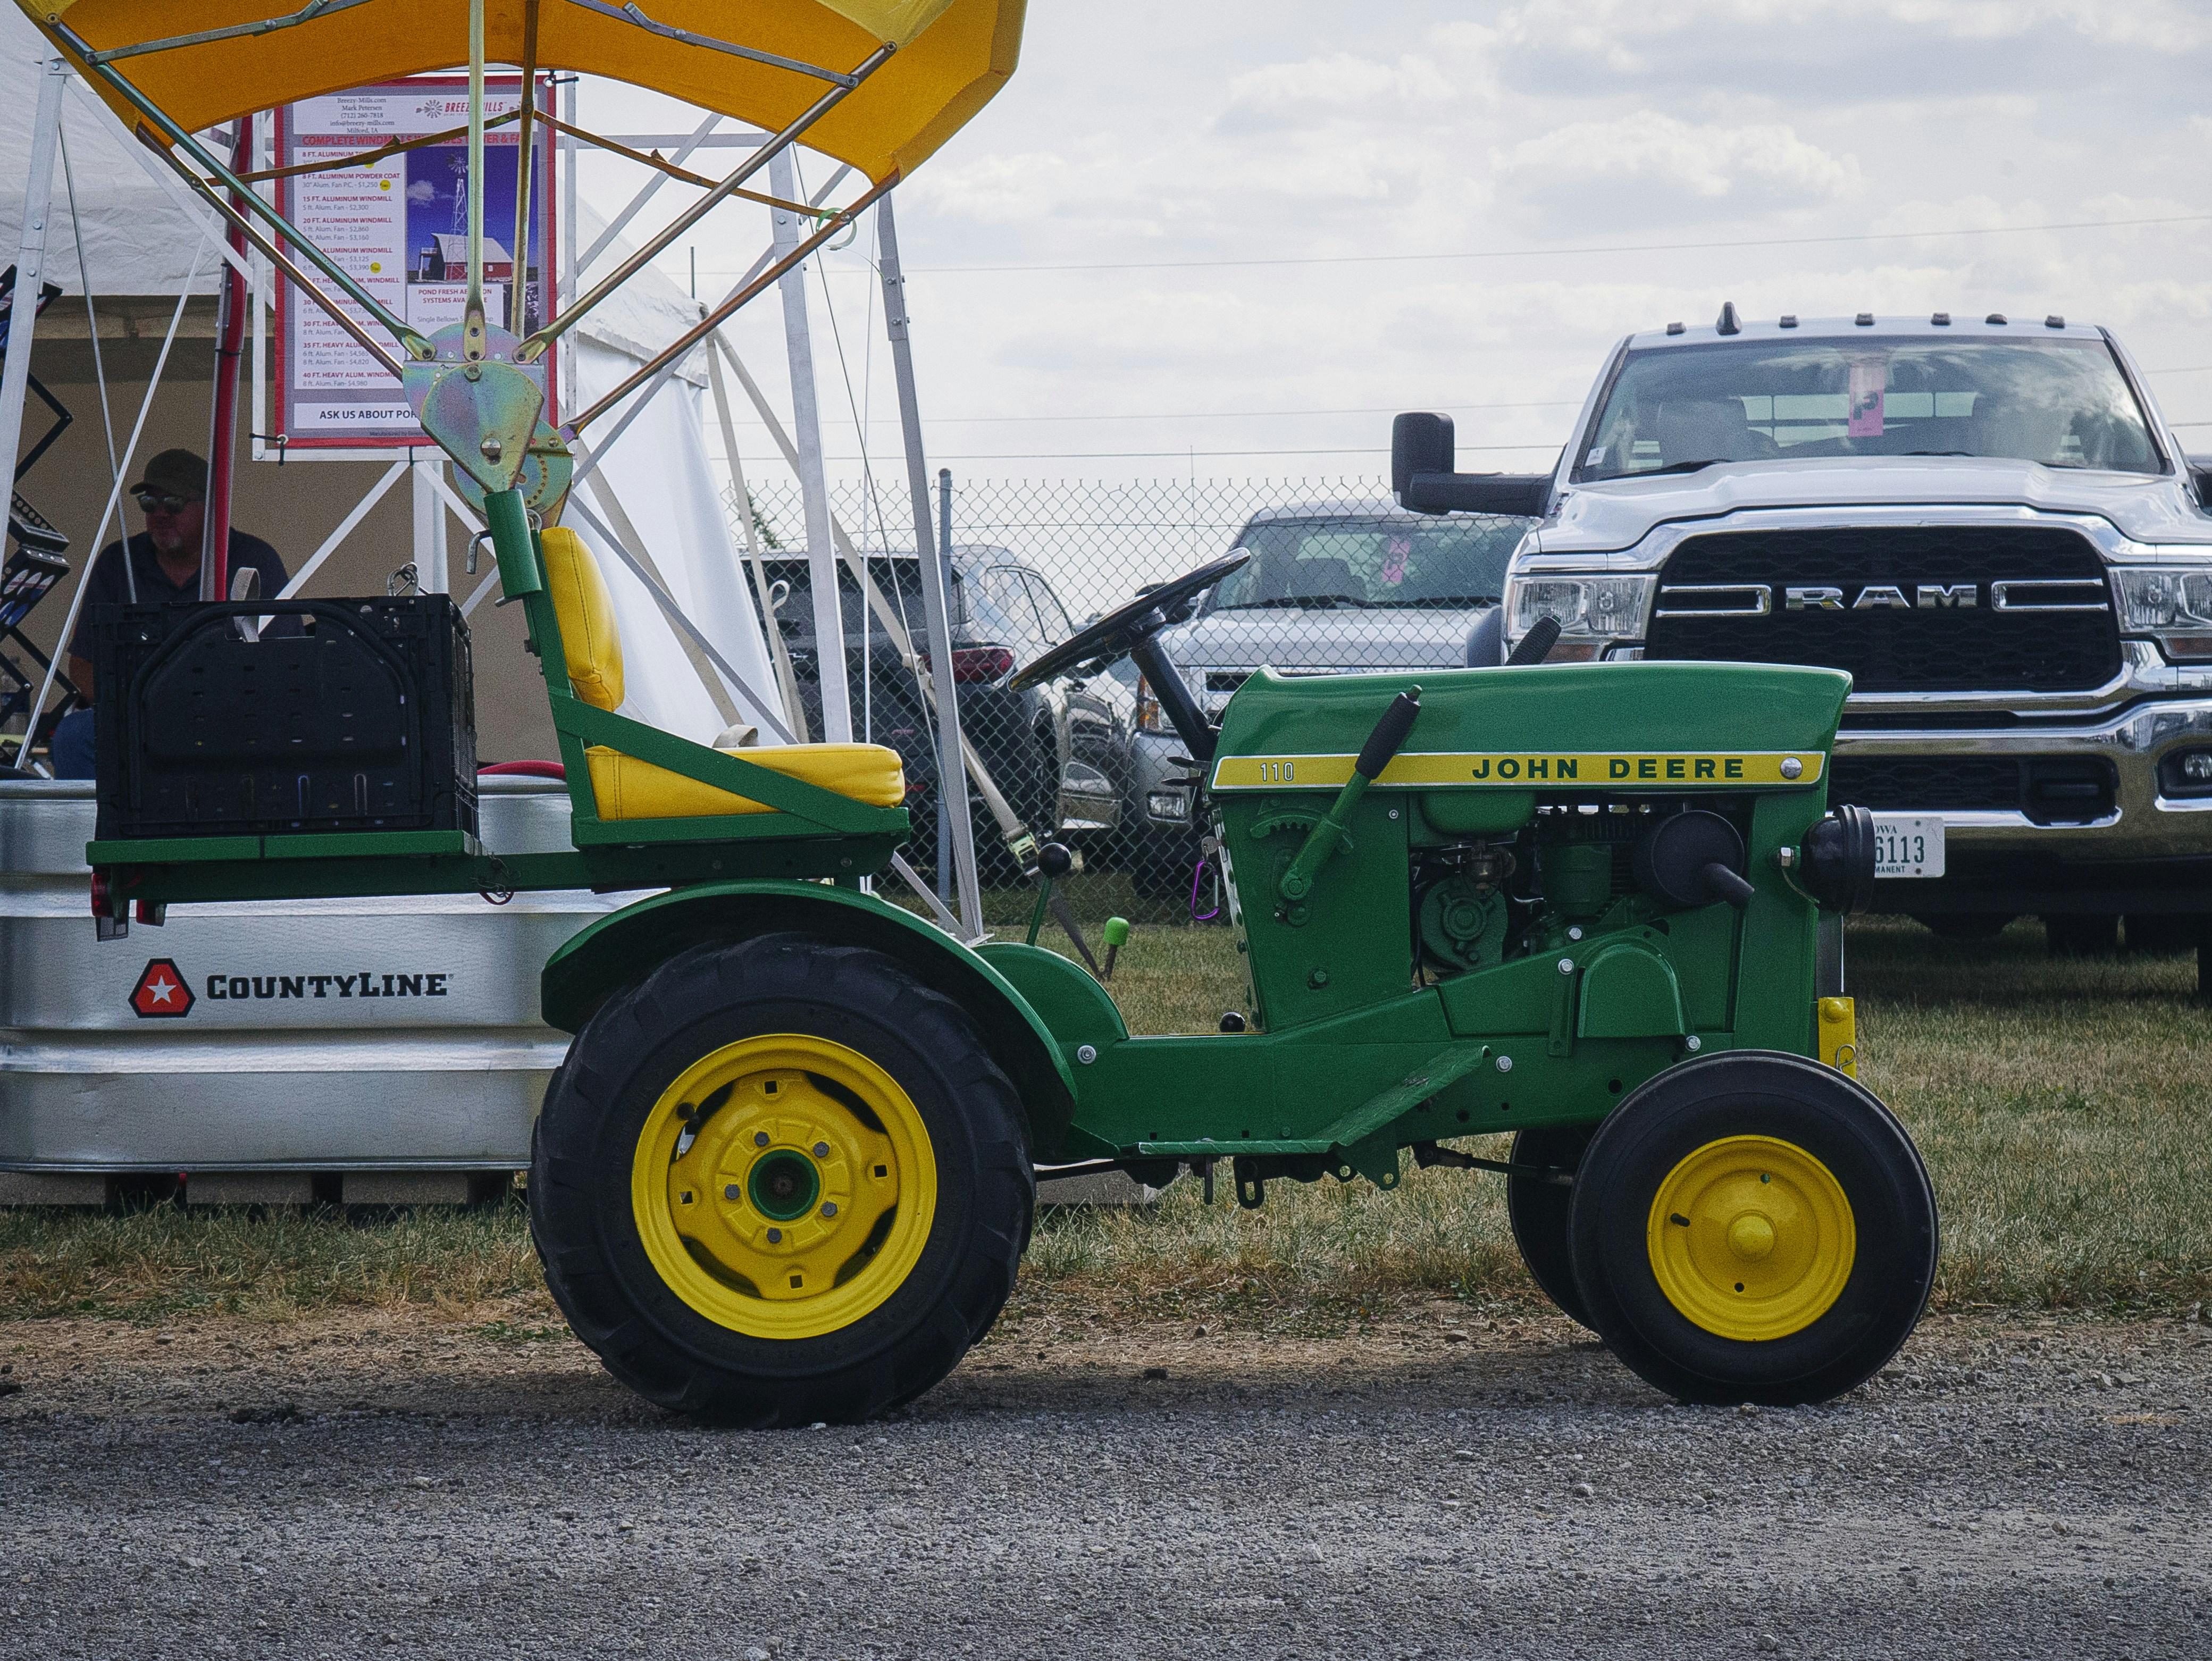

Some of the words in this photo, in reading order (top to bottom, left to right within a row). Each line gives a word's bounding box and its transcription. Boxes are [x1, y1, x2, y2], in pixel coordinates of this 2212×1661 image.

[302, 136, 354, 145] COMPLETE
[320, 411, 339, 419] ASK
[342, 410, 355, 419] US
[358, 410, 394, 419] ABOUT
[1786, 584, 1977, 609] RAM
[1260, 762, 1293, 781] 110
[1472, 758, 1577, 779] JOHN
[1609, 758, 1744, 779] DEERE
